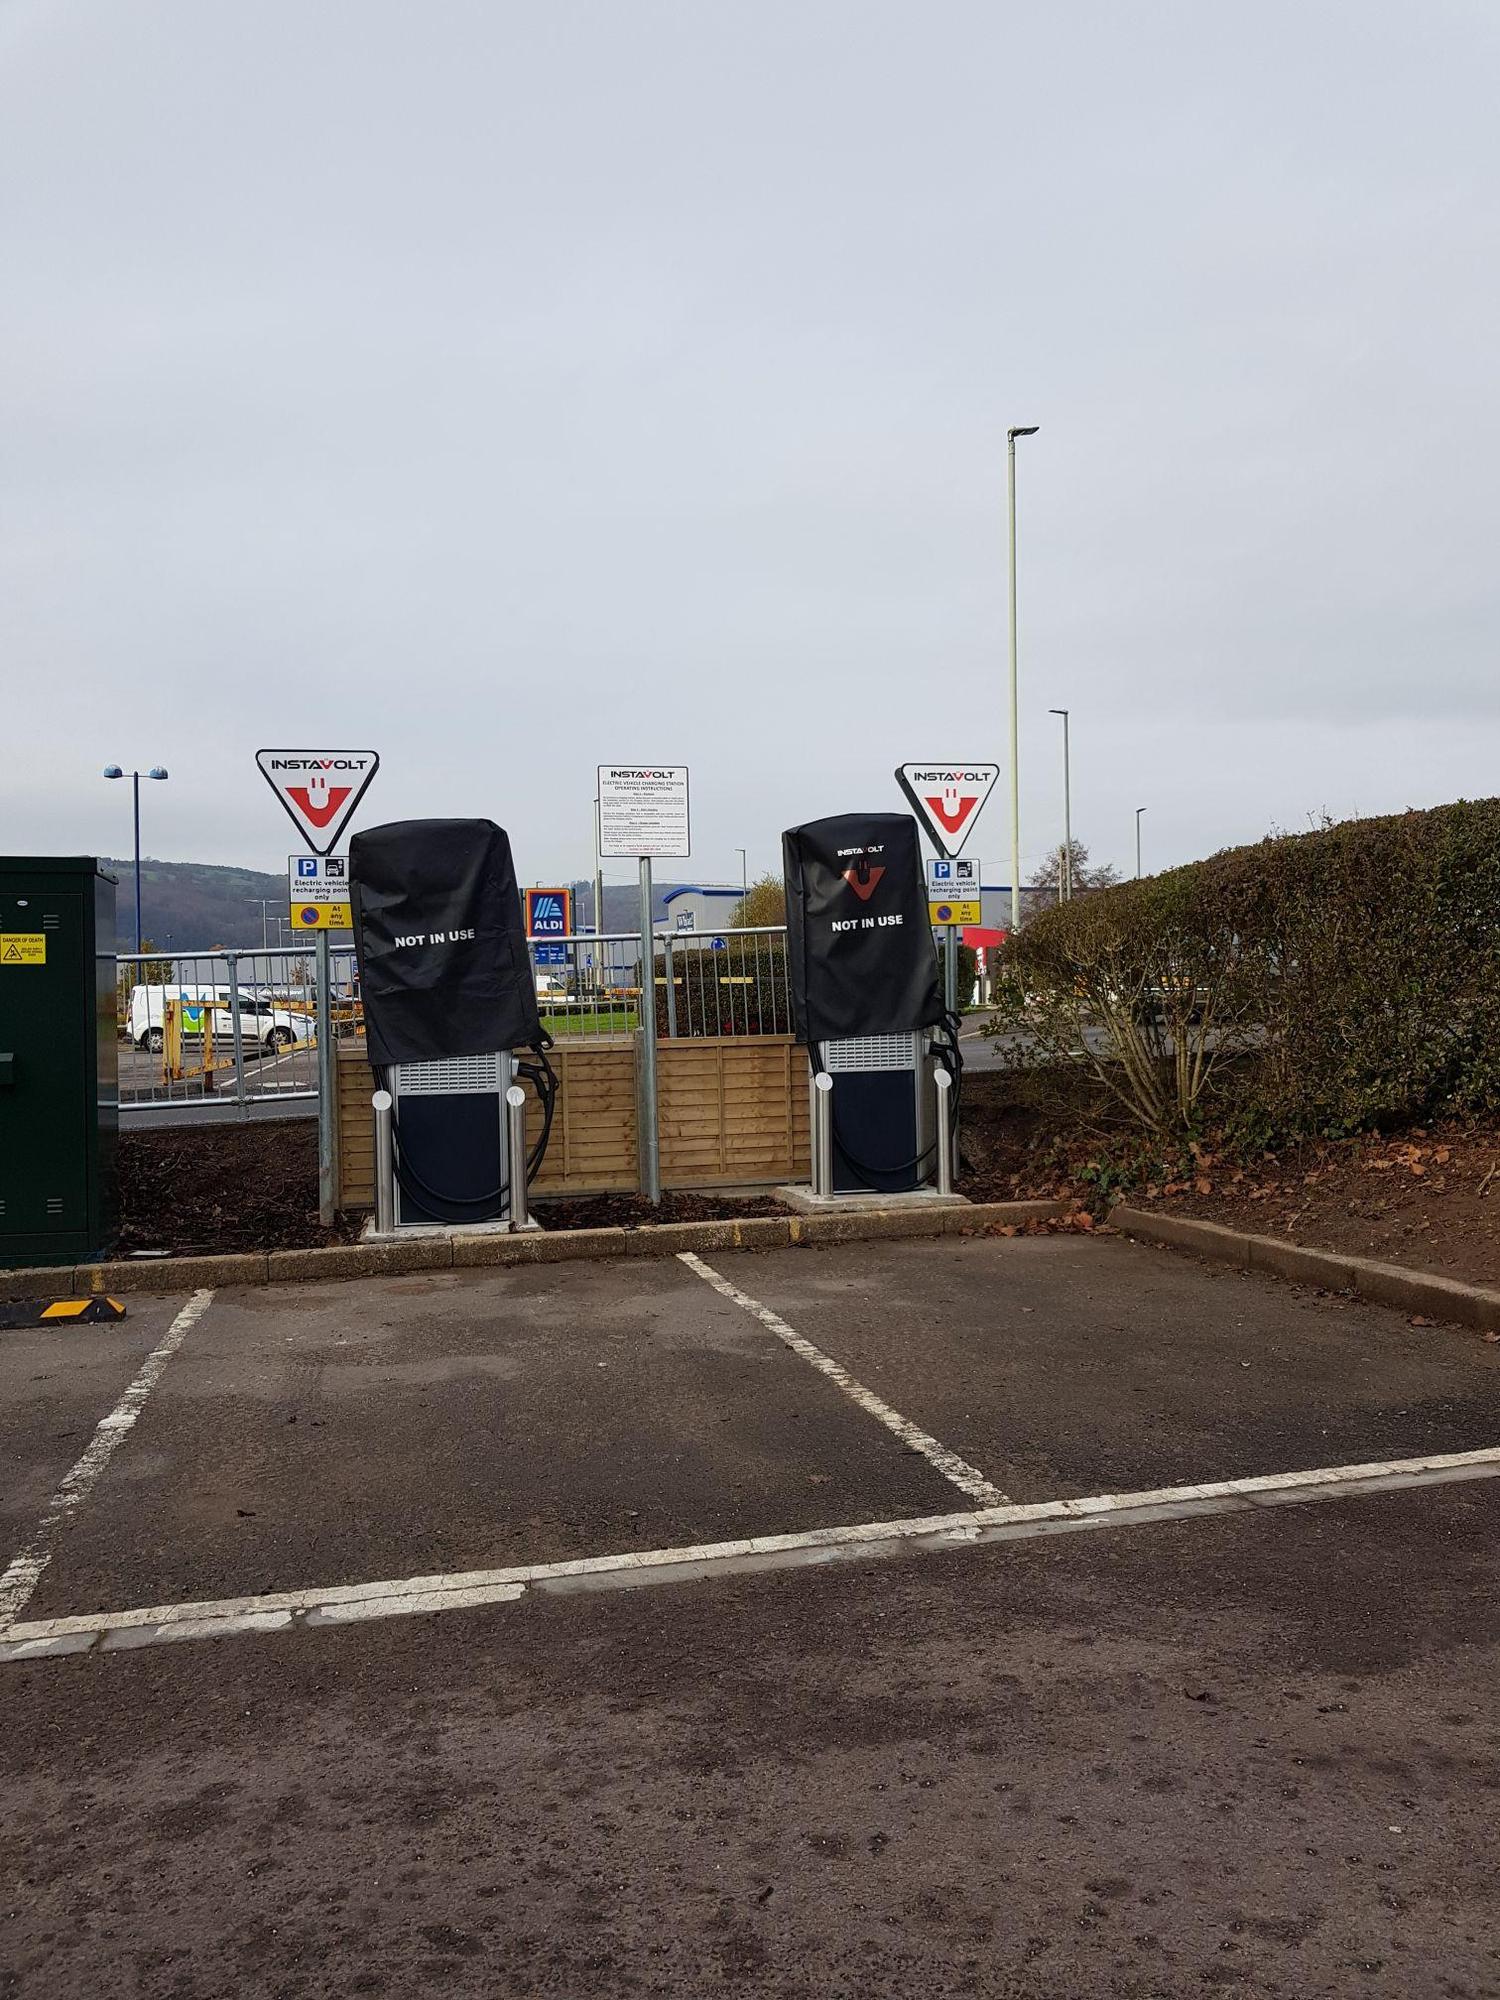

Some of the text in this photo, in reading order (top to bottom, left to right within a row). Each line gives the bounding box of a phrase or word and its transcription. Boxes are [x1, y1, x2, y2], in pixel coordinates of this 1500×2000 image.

[271, 759, 368, 770] INSTAVOLT
[610, 770, 675, 779] INSTAVOLT
[914, 772, 991, 782] INSTAVOLT
[837, 845, 884, 857] INSTAVOLT
[302, 860, 315, 875] P
[938, 864, 948, 877] P
[534, 920, 564, 930] ALDI
[831, 914, 904, 932] NOT IN USE
[394, 928, 475, 948] NOT IN USE
